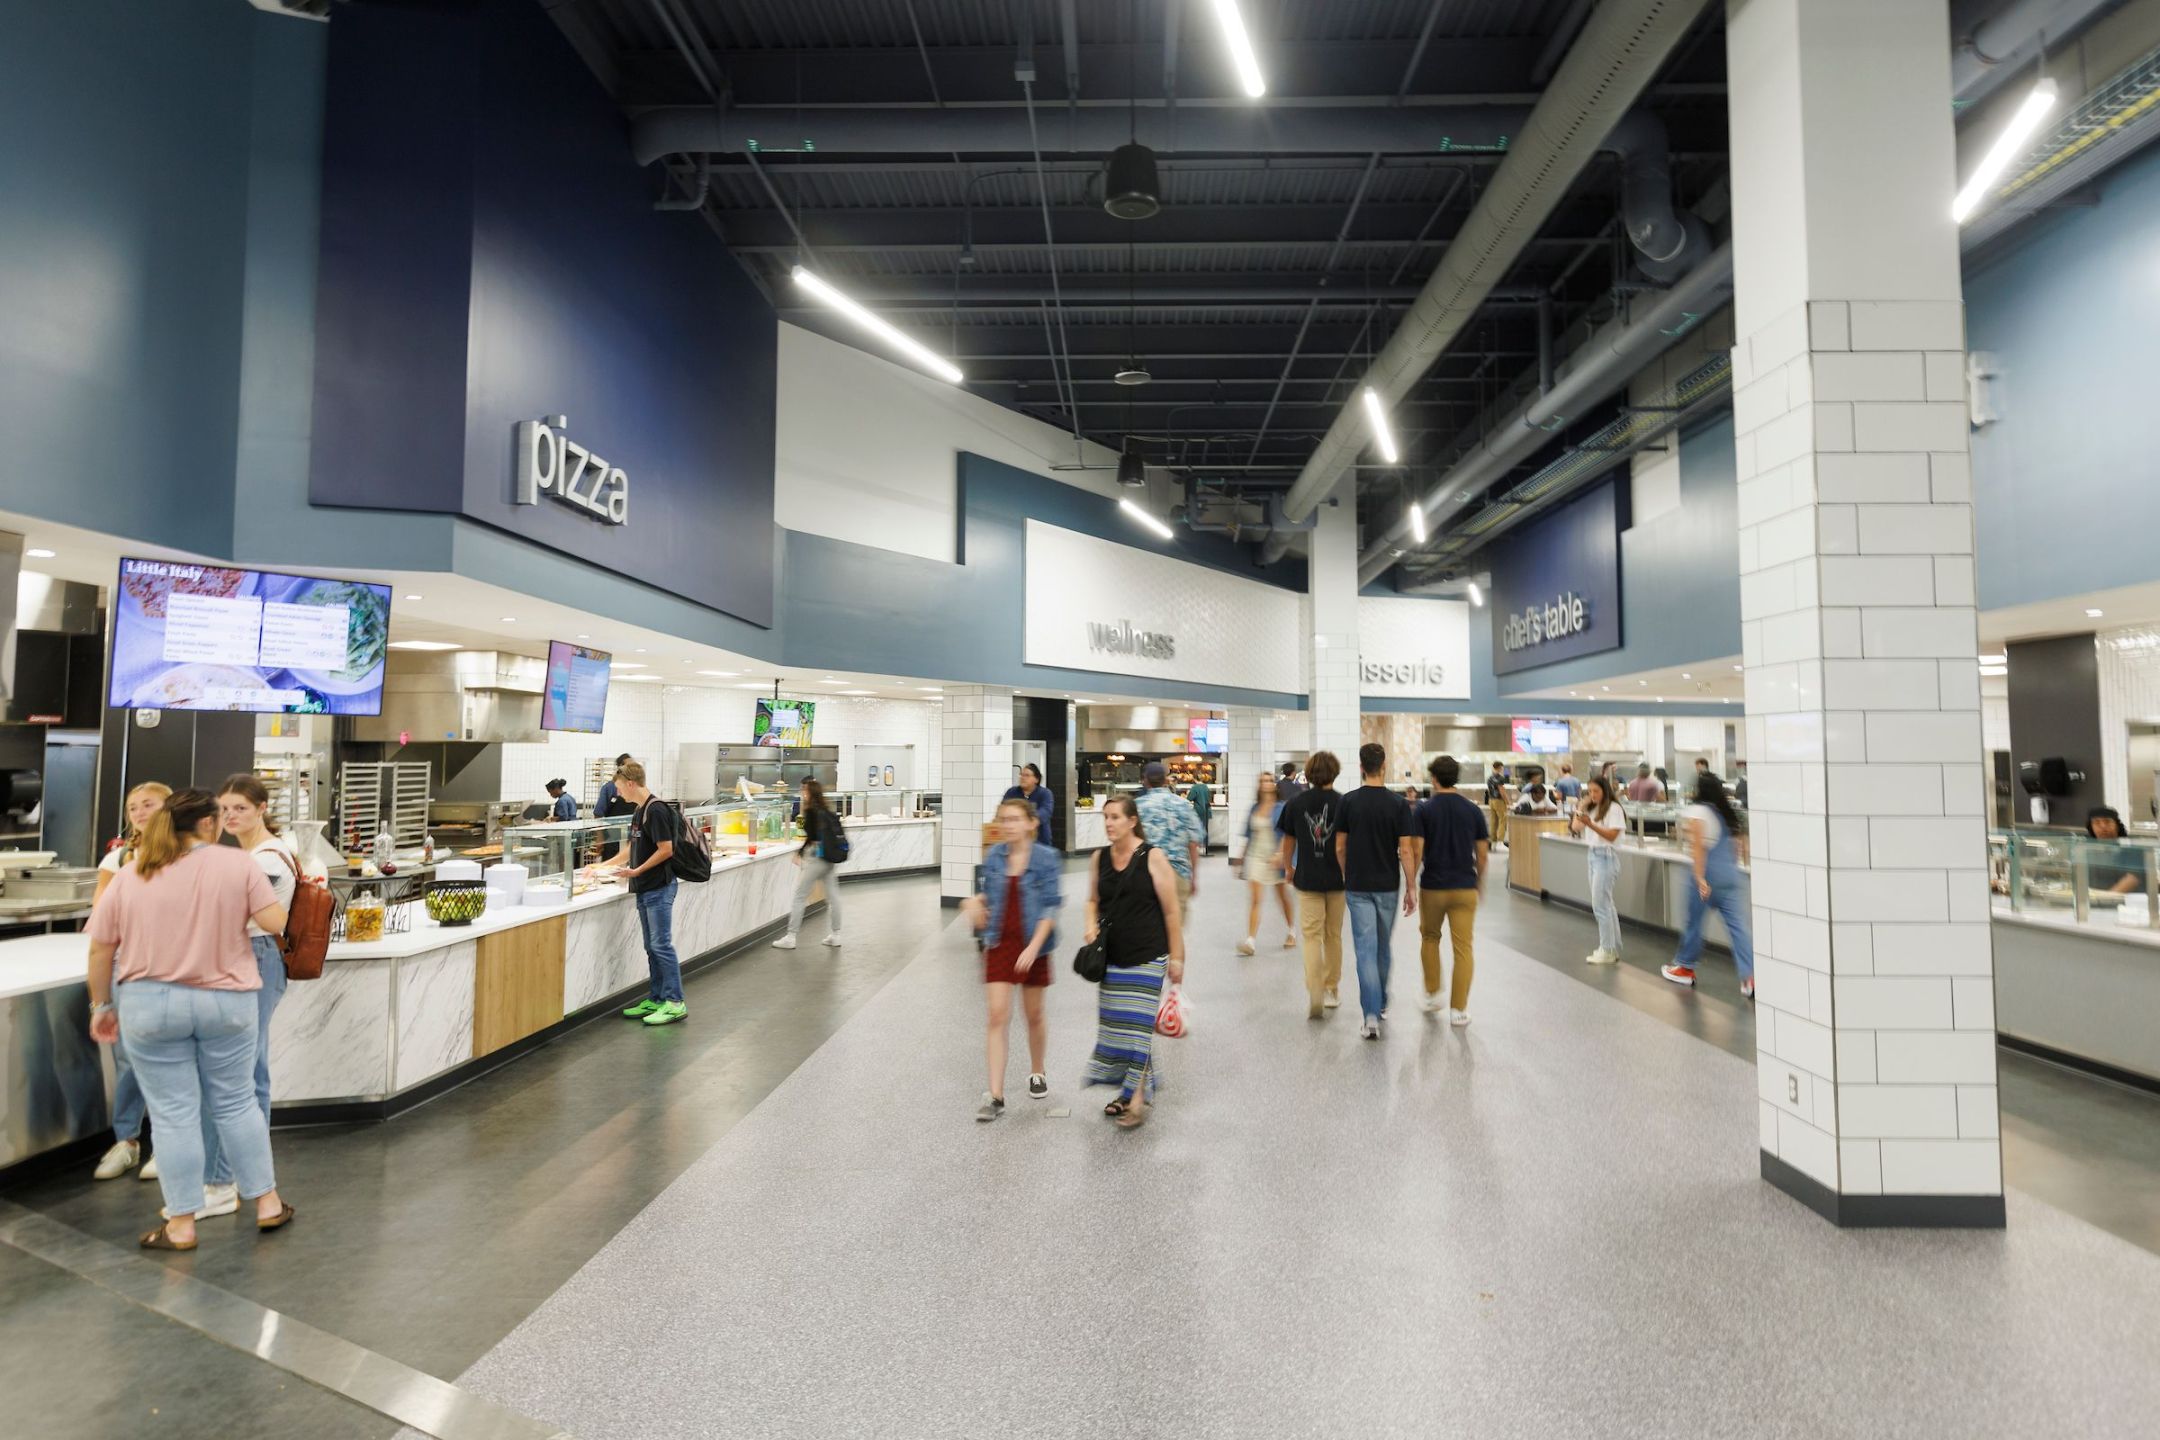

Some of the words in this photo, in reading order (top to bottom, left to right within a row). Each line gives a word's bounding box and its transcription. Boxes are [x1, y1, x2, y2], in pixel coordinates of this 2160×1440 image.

[519, 414, 629, 526] pizza
[127, 560, 168, 576] Little
[169, 564, 203, 582] Italy
[1086, 619, 1175, 660] wellness
[1503, 605, 1541, 651] chef's
[1544, 591, 1584, 640] table
[1359, 653, 1447, 685] isserie
